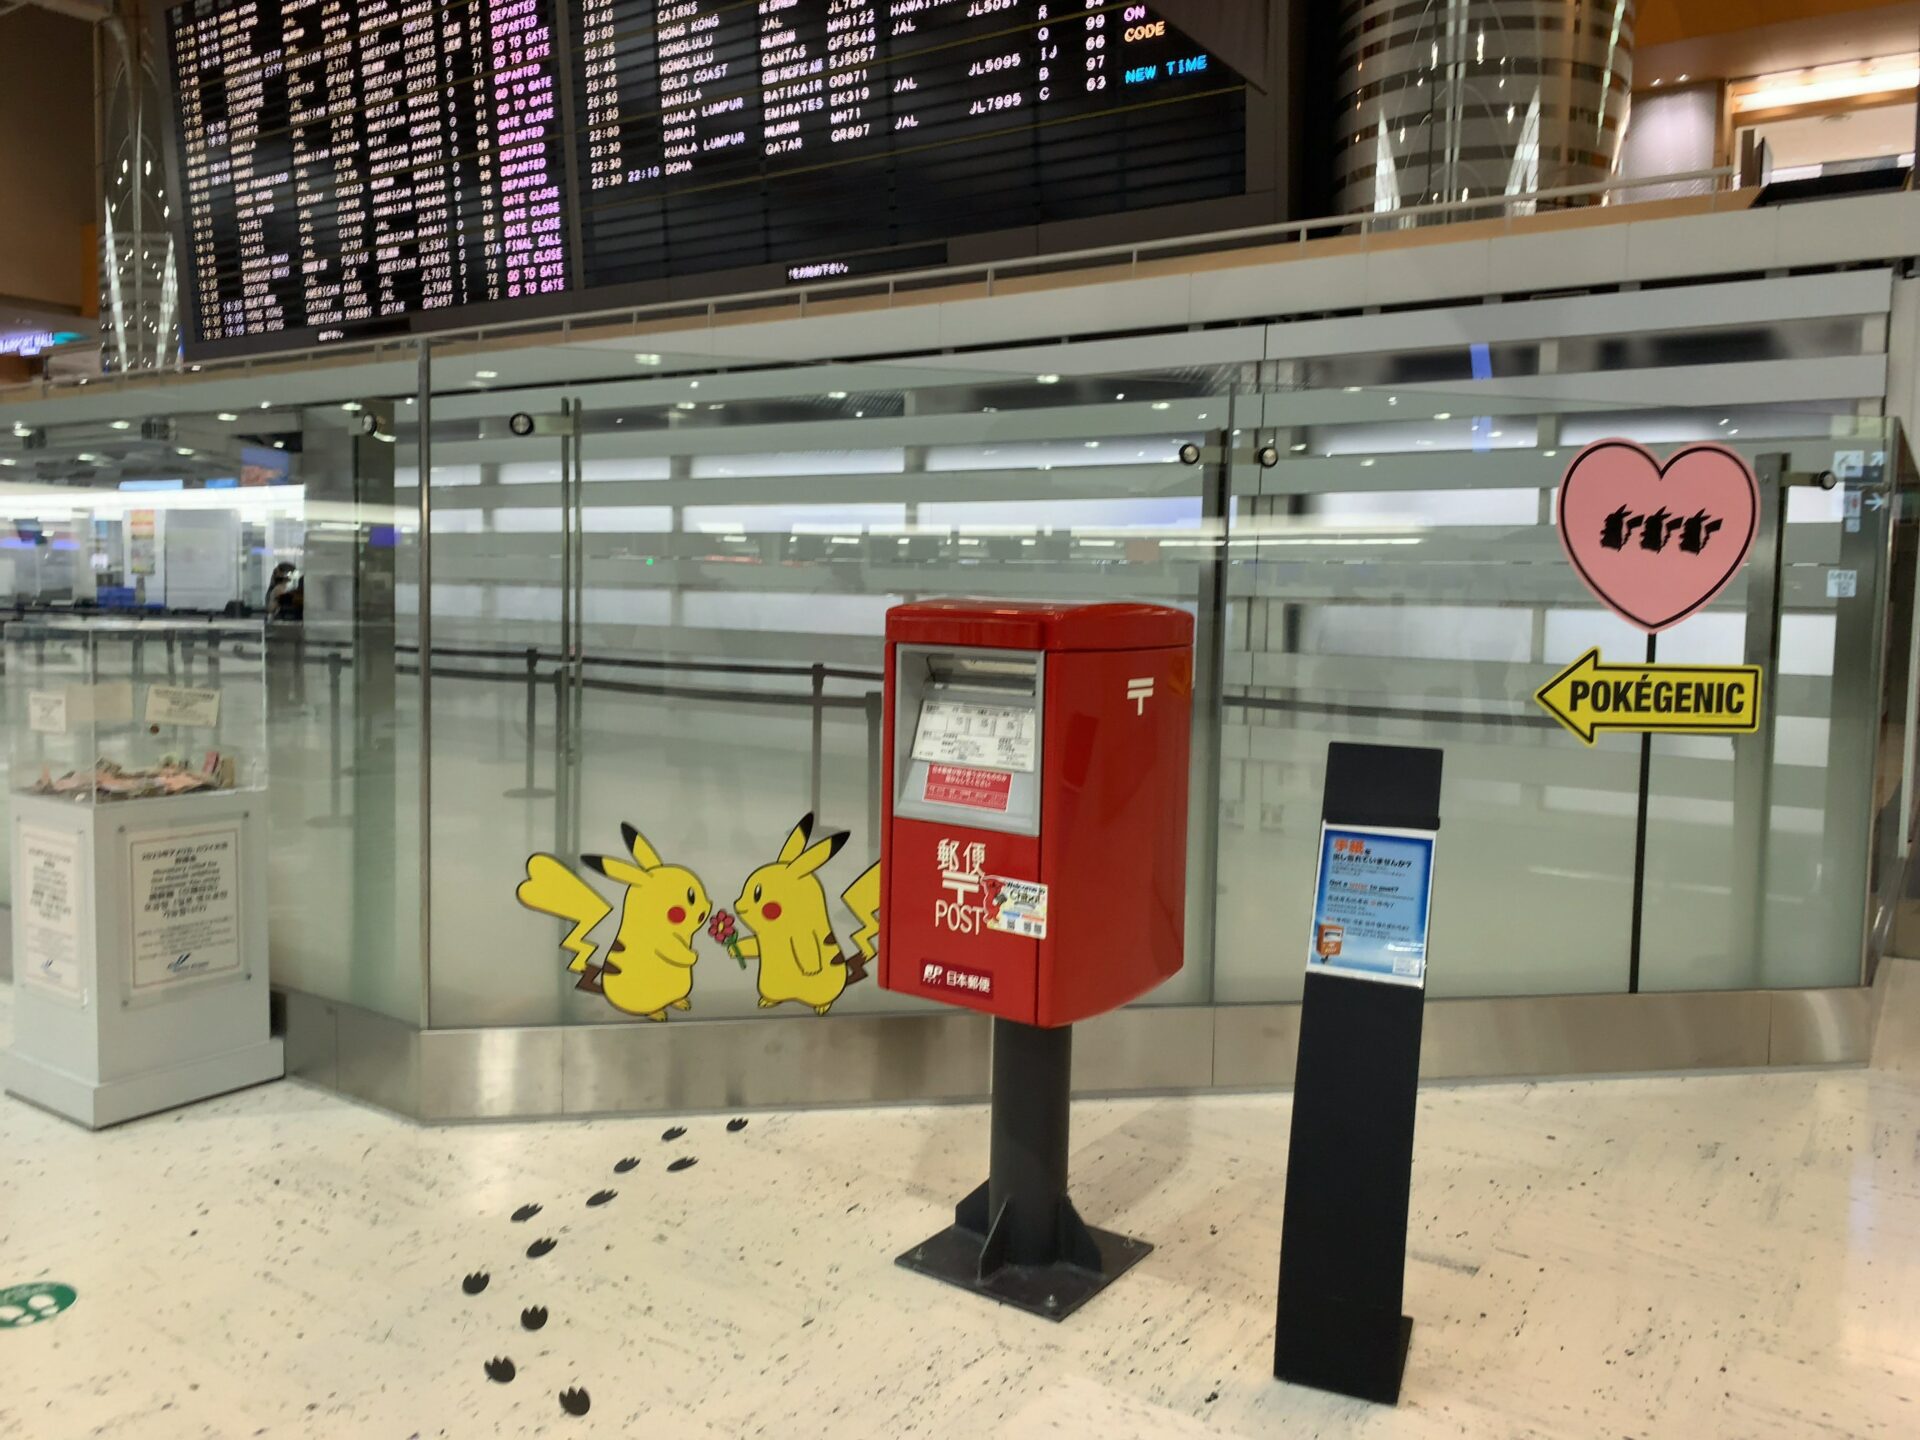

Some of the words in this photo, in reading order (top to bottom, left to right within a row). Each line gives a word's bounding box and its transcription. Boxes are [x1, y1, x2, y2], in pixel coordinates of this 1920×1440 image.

[490, 0, 536, 23] DEPARTED
[657, 1, 697, 24] CAIRNS
[491, 14, 537, 39] DEPARTED
[658, 23, 686, 42] HONG
[691, 14, 719, 32] KONG
[659, 35, 713, 58] HONOLULU
[762, 17, 783, 32] JAL
[508, 35, 522, 49] TO
[525, 27, 549, 44] GATE
[510, 51, 522, 64] TO
[526, 42, 550, 60] GATE
[660, 52, 714, 75] HONOLULU
[661, 74, 688, 91] GOLD
[693, 63, 728, 83] COAST
[762, 44, 806, 67] QANTAS
[892, 20, 916, 35] JAL
[494, 63, 540, 85] DEPARTED
[590, 126, 620, 142] 22:00
[663, 109, 696, 125] KUALA
[702, 97, 744, 117] LUMPUR
[1086, 14, 1105, 30] 99
[1124, 6, 1145, 21] ON
[512, 83, 525, 95] TO
[528, 76, 552, 91] GATE
[590, 142, 620, 158] 22:30
[664, 125, 696, 142] DUBAI
[764, 97, 824, 120] EMIRATES
[830, 87, 869, 106] EK319
[894, 77, 917, 92] JAL
[968, 53, 1020, 76] JL5095
[1124, 21, 1164, 42] CODE
[529, 92, 553, 107] GATE
[662, 88, 702, 108] MANILA
[497, 116, 520, 130] GATE
[524, 107, 554, 124] CLOSE
[592, 158, 621, 173] 22:30
[664, 142, 698, 158] KUALA
[704, 132, 745, 150] LUMPUR
[830, 107, 860, 124] MH71
[1086, 55, 1104, 71] 97
[592, 174, 622, 189] 22:30
[666, 160, 692, 175] DOHA
[766, 138, 802, 155] QATAR
[895, 115, 918, 129] JAL
[969, 93, 1021, 114] JL7995
[1125, 66, 1156, 84] NEW
[1166, 55, 1207, 75] TIME
[498, 126, 544, 146] DEPARTED
[500, 142, 545, 162] DEPARTED
[500, 158, 546, 177] DEPARTED
[502, 173, 547, 192] DEPARTED
[502, 193, 526, 207] GATE
[529, 186, 559, 201] CLOSE
[503, 208, 526, 222] GATE
[530, 201, 560, 217] CLOSE
[504, 222, 528, 238] GATE
[532, 216, 561, 233] CLOSE
[506, 237, 534, 252] FINAL
[538, 232, 562, 247] CALL
[506, 252, 529, 267] GATE
[534, 247, 563, 263] CLOSE
[524, 267, 536, 279] TO
[540, 262, 563, 277] GATE
[524, 282, 537, 294] TO
[541, 278, 564, 292] GATE
[1569, 673, 1744, 714] POKÉGENIC
[936, 838, 986, 878] 郵便
[934, 899, 984, 936] POST
[946, 970, 990, 993] 日本郵便
